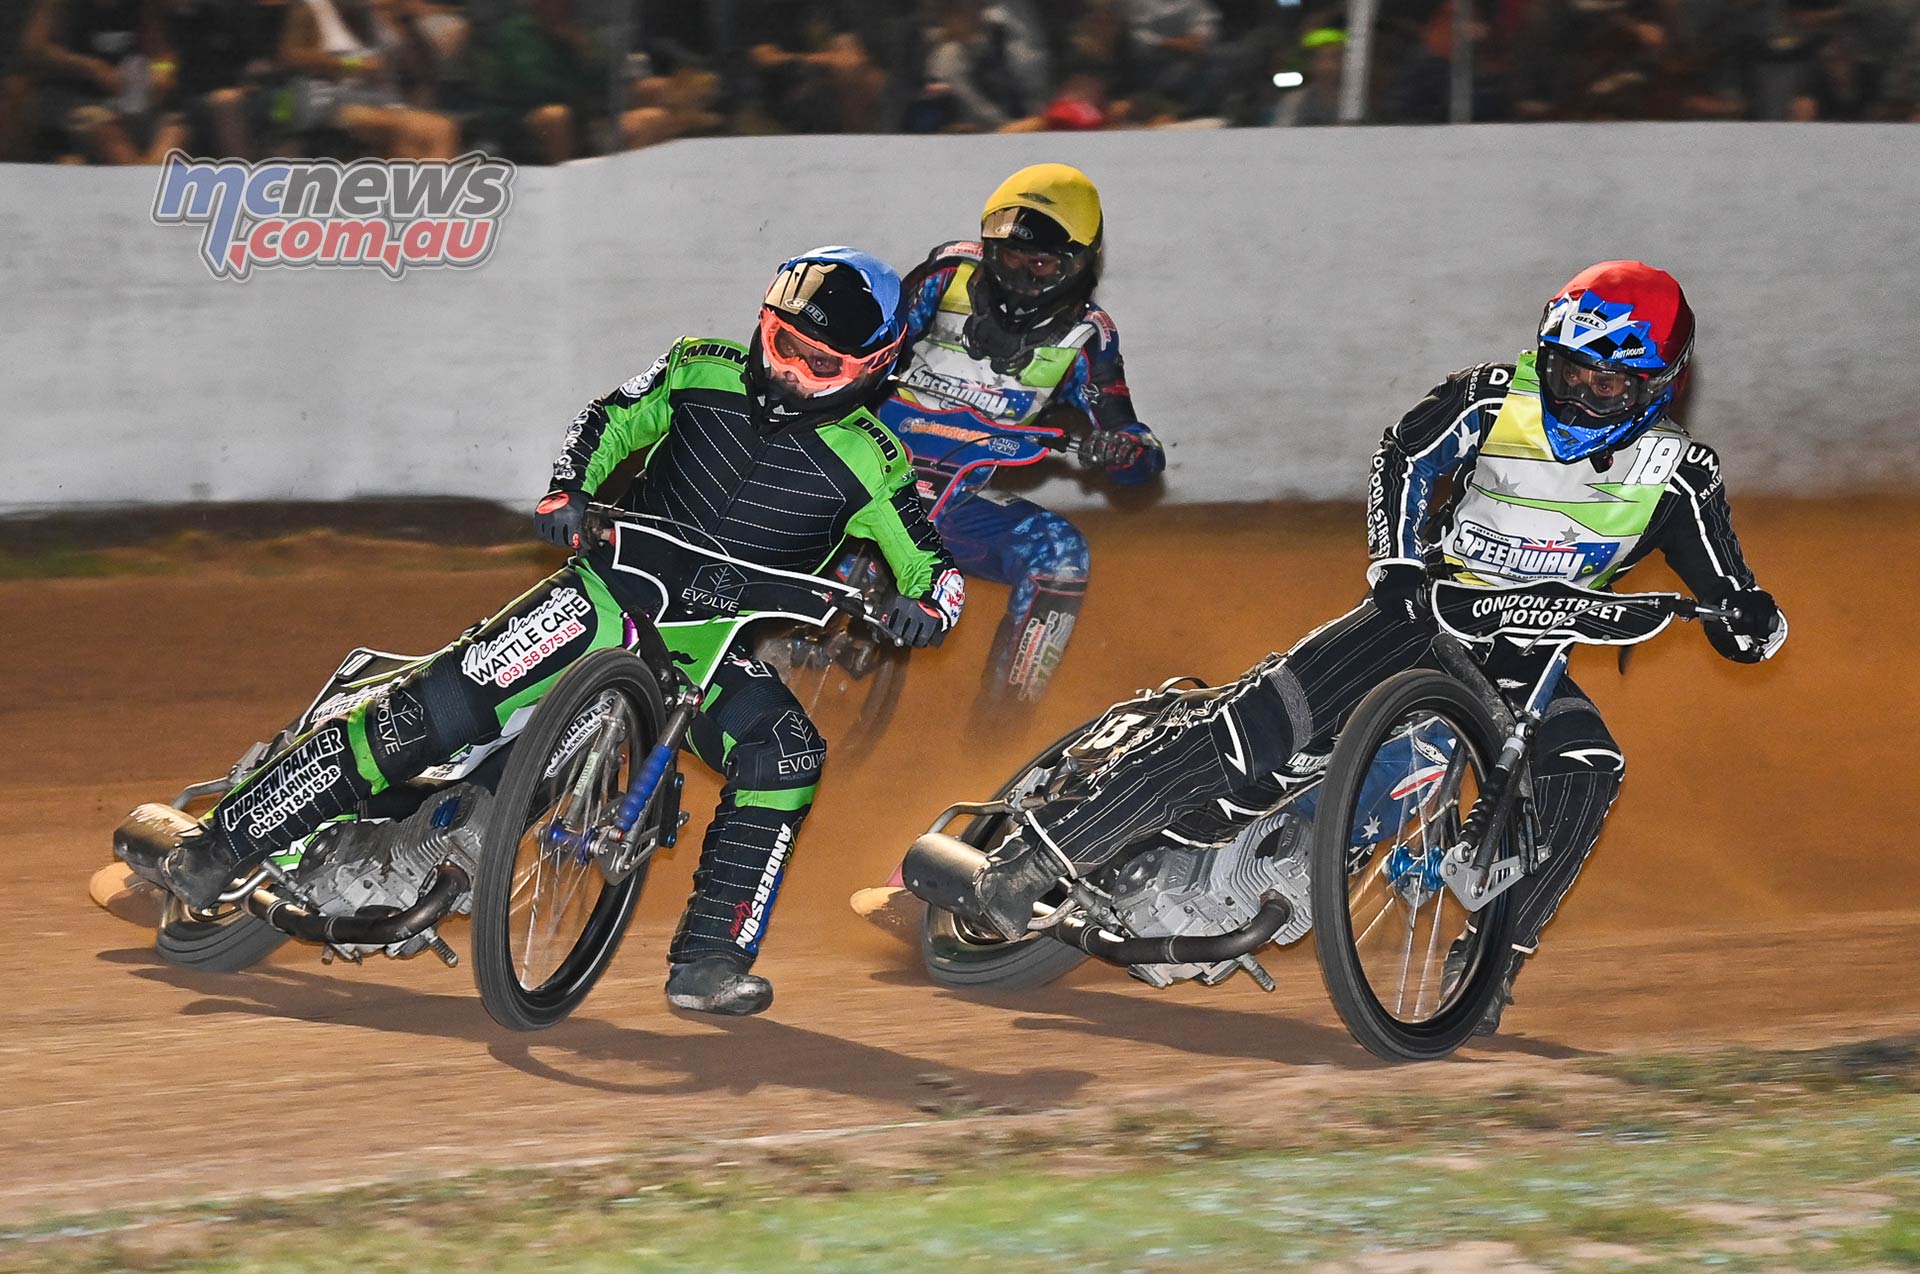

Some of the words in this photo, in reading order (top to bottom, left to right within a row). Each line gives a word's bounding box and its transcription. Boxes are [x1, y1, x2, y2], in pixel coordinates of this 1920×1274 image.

[791, 299, 825, 322] SHOEI
[1574, 315, 1600, 329] BELL
[853, 416, 898, 461] DAD
[1622, 436, 1682, 485] 18
[1454, 522, 1586, 582] SPEEDWAY
[681, 588, 740, 614] EVOLVE
[1499, 608, 1577, 627] MOTORS
[1550, 597, 1627, 623] STREET
[469, 628, 541, 685] WATTLE
[539, 593, 589, 634] CAFE
[497, 661, 525, 687] (03)
[521, 648, 541, 669] 58
[538, 632, 565, 657] 875
[562, 620, 584, 640] 151
[224, 767, 283, 830] ANDREW
[280, 729, 343, 785] PALMER
[249, 808, 285, 838] 0428
[282, 785, 313, 814] 184
[311, 766, 340, 793] 528
[252, 765, 322, 822] SHEARING
[735, 823, 791, 949] ANDERSON
